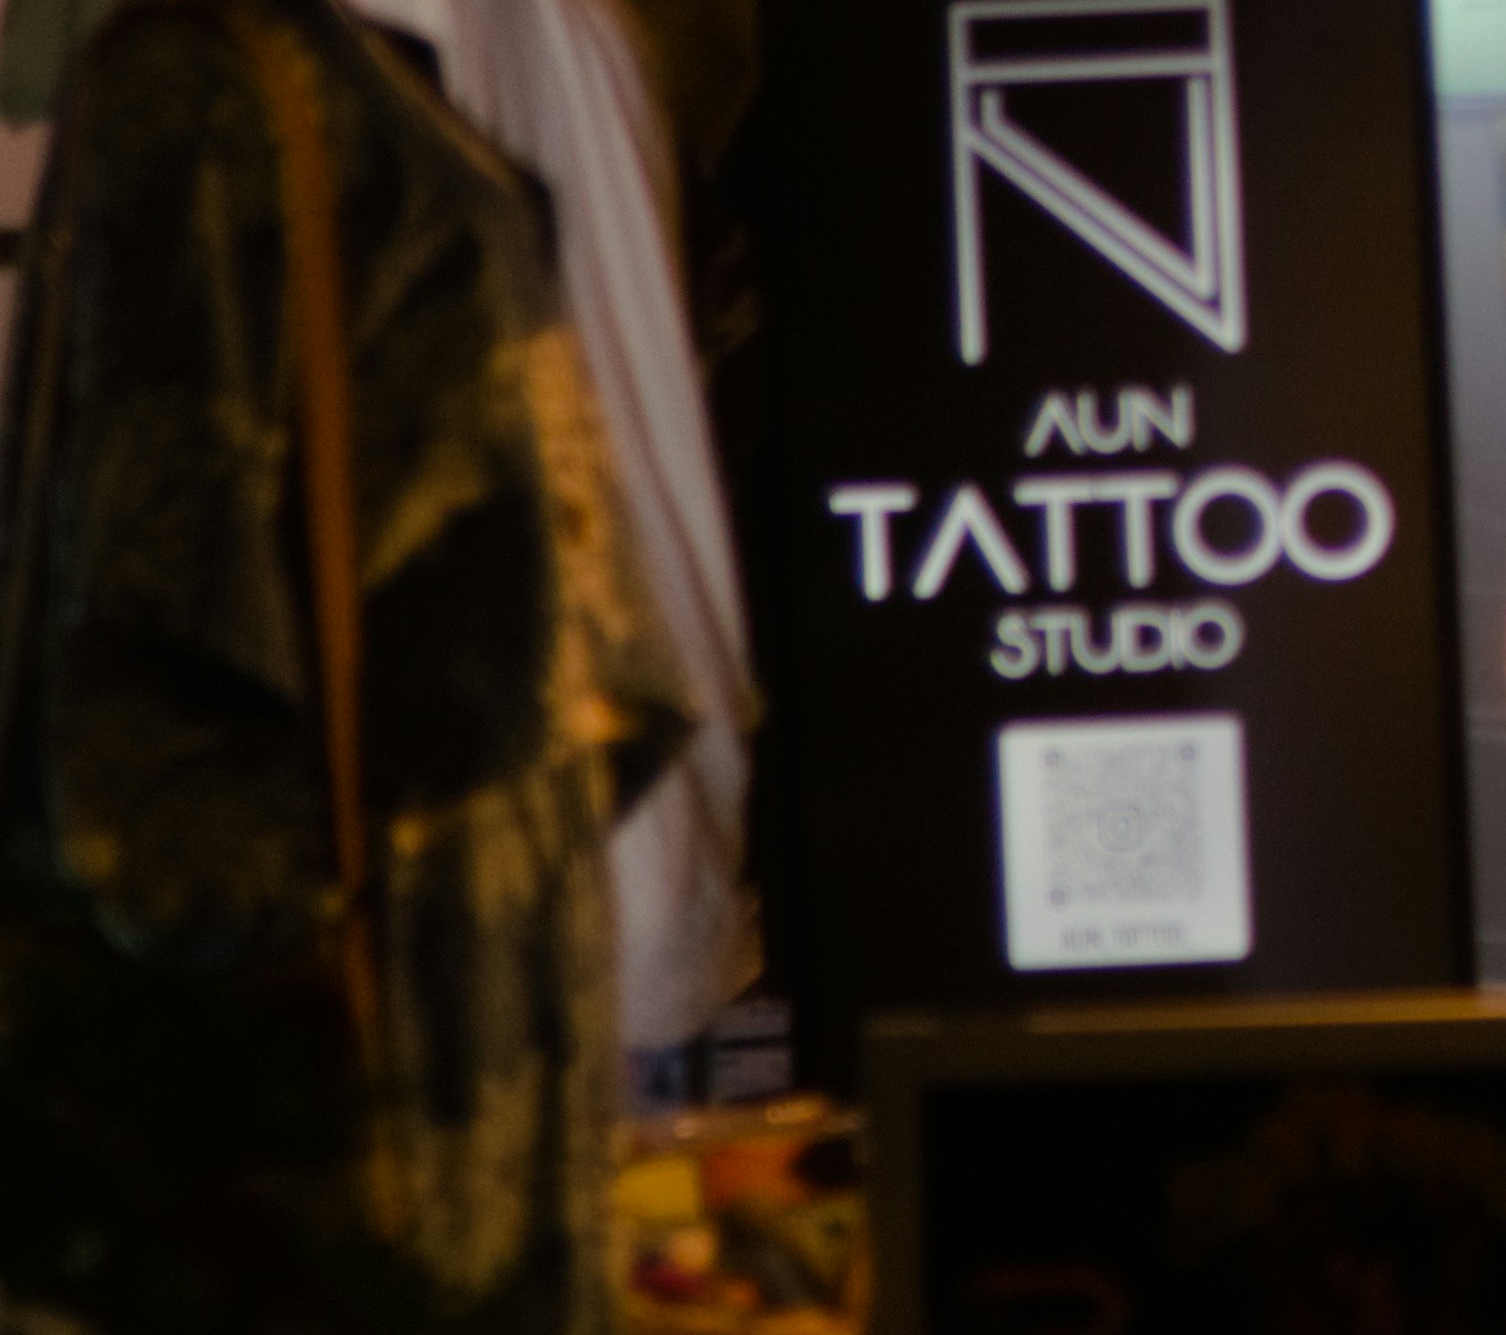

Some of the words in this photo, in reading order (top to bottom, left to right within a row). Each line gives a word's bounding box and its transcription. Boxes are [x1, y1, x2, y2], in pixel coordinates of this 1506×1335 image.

[1025, 387, 1193, 457] AUN
[829, 458, 1395, 602] TATTOO
[990, 599, 1243, 679] STUDIO
